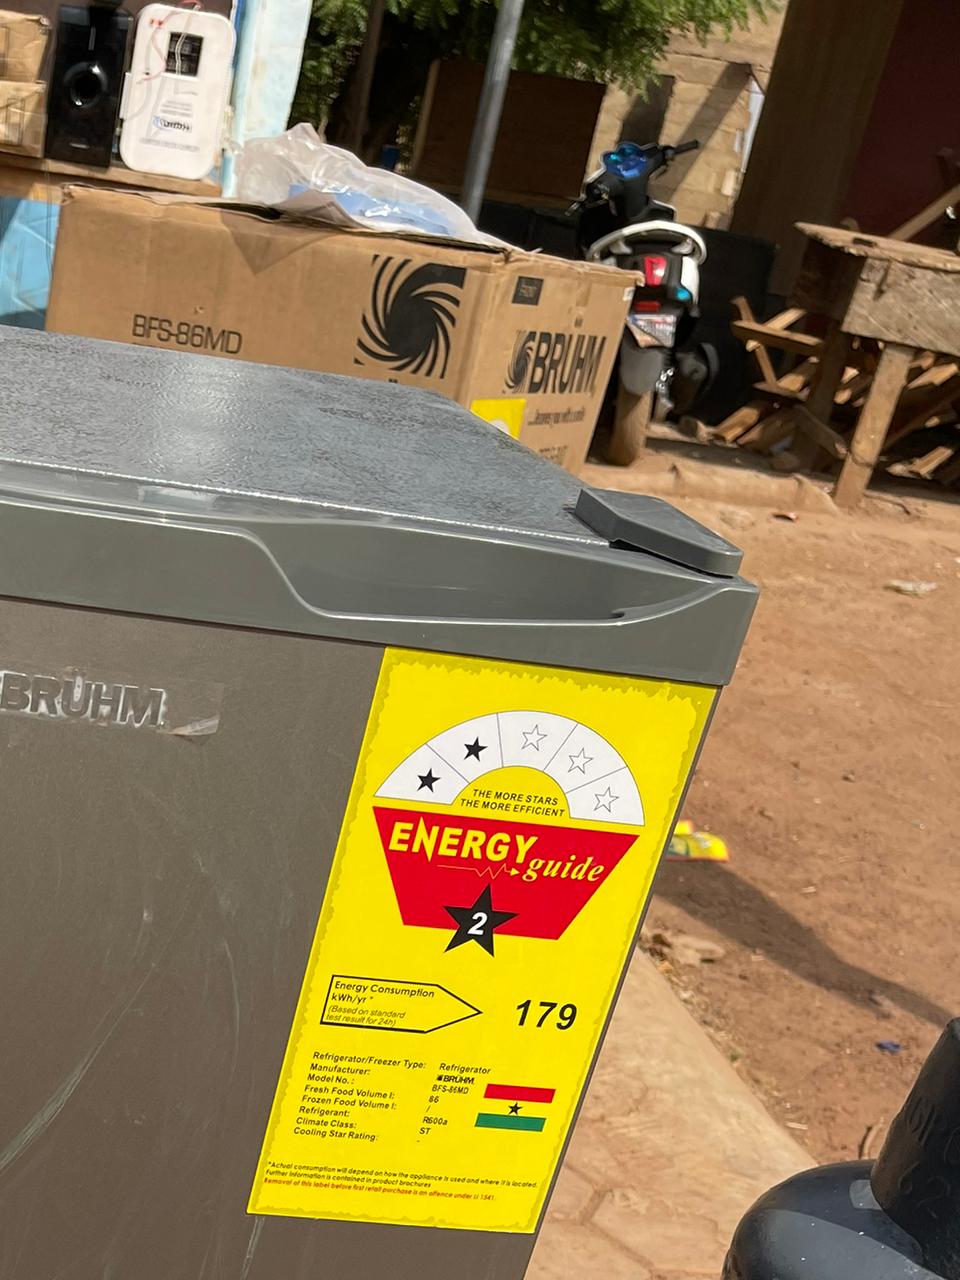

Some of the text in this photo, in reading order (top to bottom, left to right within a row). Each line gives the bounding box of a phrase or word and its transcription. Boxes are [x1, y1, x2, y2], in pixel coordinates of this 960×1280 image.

[132, 314, 242, 354] BFS-86MD
[473, 789, 558, 806] THE MORE STARS
[460, 799, 565, 817] THE MORE EFFICIENT
[388, 816, 538, 864] ENERGY
[522, 855, 605, 882] guide
[467, 913, 488, 935] 2
[334, 981, 435, 998] Energy Consumption
[331, 993, 367, 1004] kWh/yr
[328, 1005, 358, 1015] (Based
[370, 1010, 406, 1019] standard
[515, 999, 578, 1031] 179
[342, 1015, 365, 1023] result
[366, 1016, 376, 1024] for
[378, 1018, 396, 1027] 24h)
[309, 1063, 371, 1076] Manufacturer:
[313, 1051, 491, 1075] Refrigerator/Freezer Type: Refrigerator
[307, 1074, 334, 1084] Model
[304, 1084, 329, 1094] Fresh
[331, 1086, 354, 1097] Food
[356, 1089, 387, 1099] Volume
[302, 1095, 332, 1105] Frozen
[332, 1097, 356, 1107] Food
[358, 1099, 390, 1110] Volume
[299, 1106, 448, 1125] Refrigerant: R600a
[293, 1127, 328, 1138] Cooling
[329, 1130, 346, 1139] Star
[348, 1132, 378, 1142] Rating:
[296, 1117, 431, 1135] Climate Class: ST
[289, 1171, 325, 1179] information
[332, 1174, 365, 1183] contained
[372, 1178, 398, 1186] product
[399, 1180, 431, 1188] brochures
[294, 1164, 335, 1173] consumption
[348, 1168, 374, 1176] depend
[410, 1173, 442, 1181] appliance
[264, 1177, 292, 1185] Removal
[331, 1182, 352, 1190] before
[382, 1187, 412, 1195] purchase
[429, 1190, 453, 1198] offence
